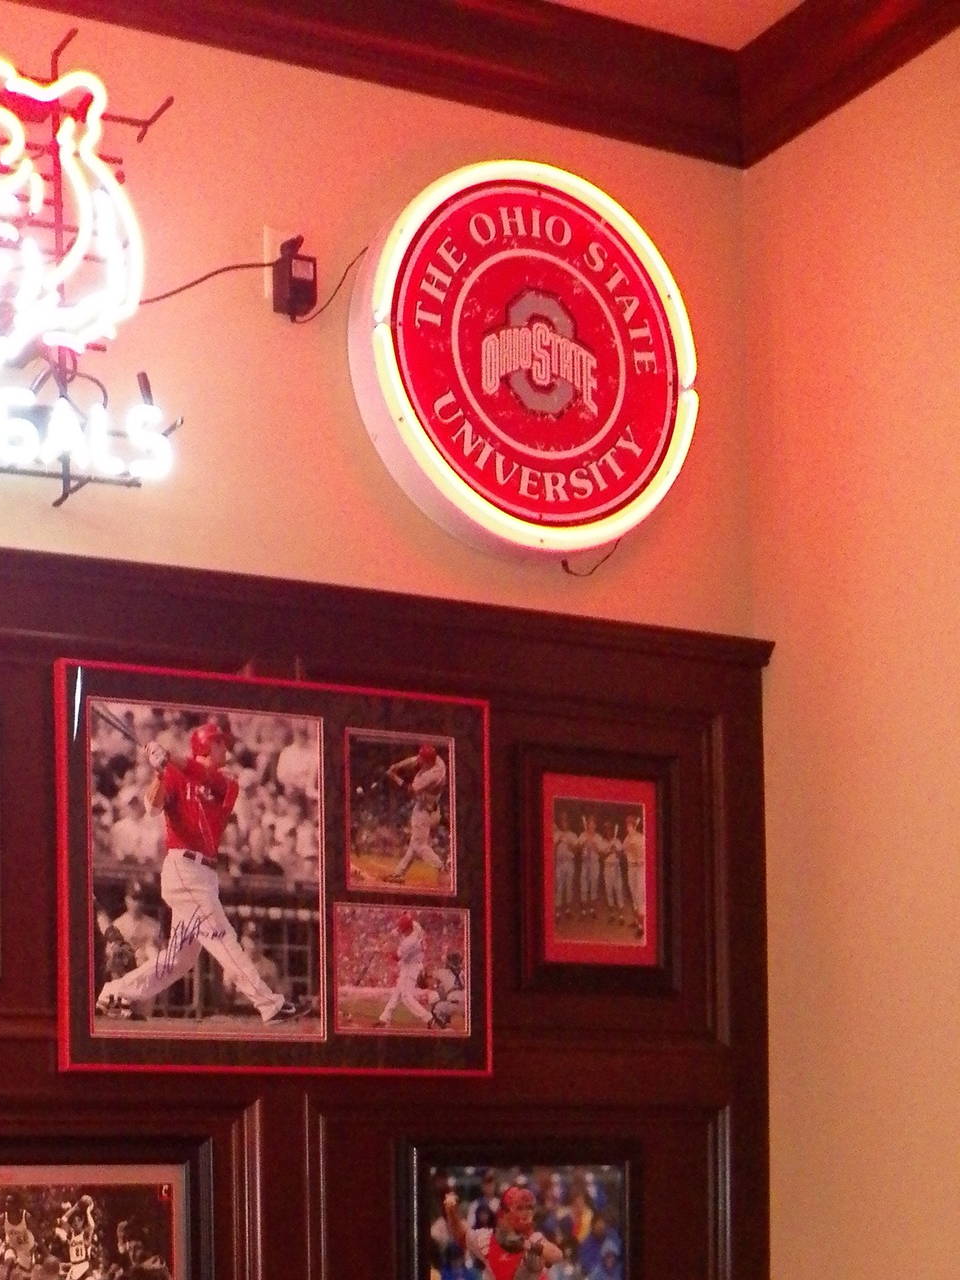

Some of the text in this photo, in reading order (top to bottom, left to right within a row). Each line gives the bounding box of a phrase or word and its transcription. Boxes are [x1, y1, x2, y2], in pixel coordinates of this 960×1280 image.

[414, 206, 658, 376] THE OHIO STATE
[433, 390, 643, 503] UNIVERSITY
